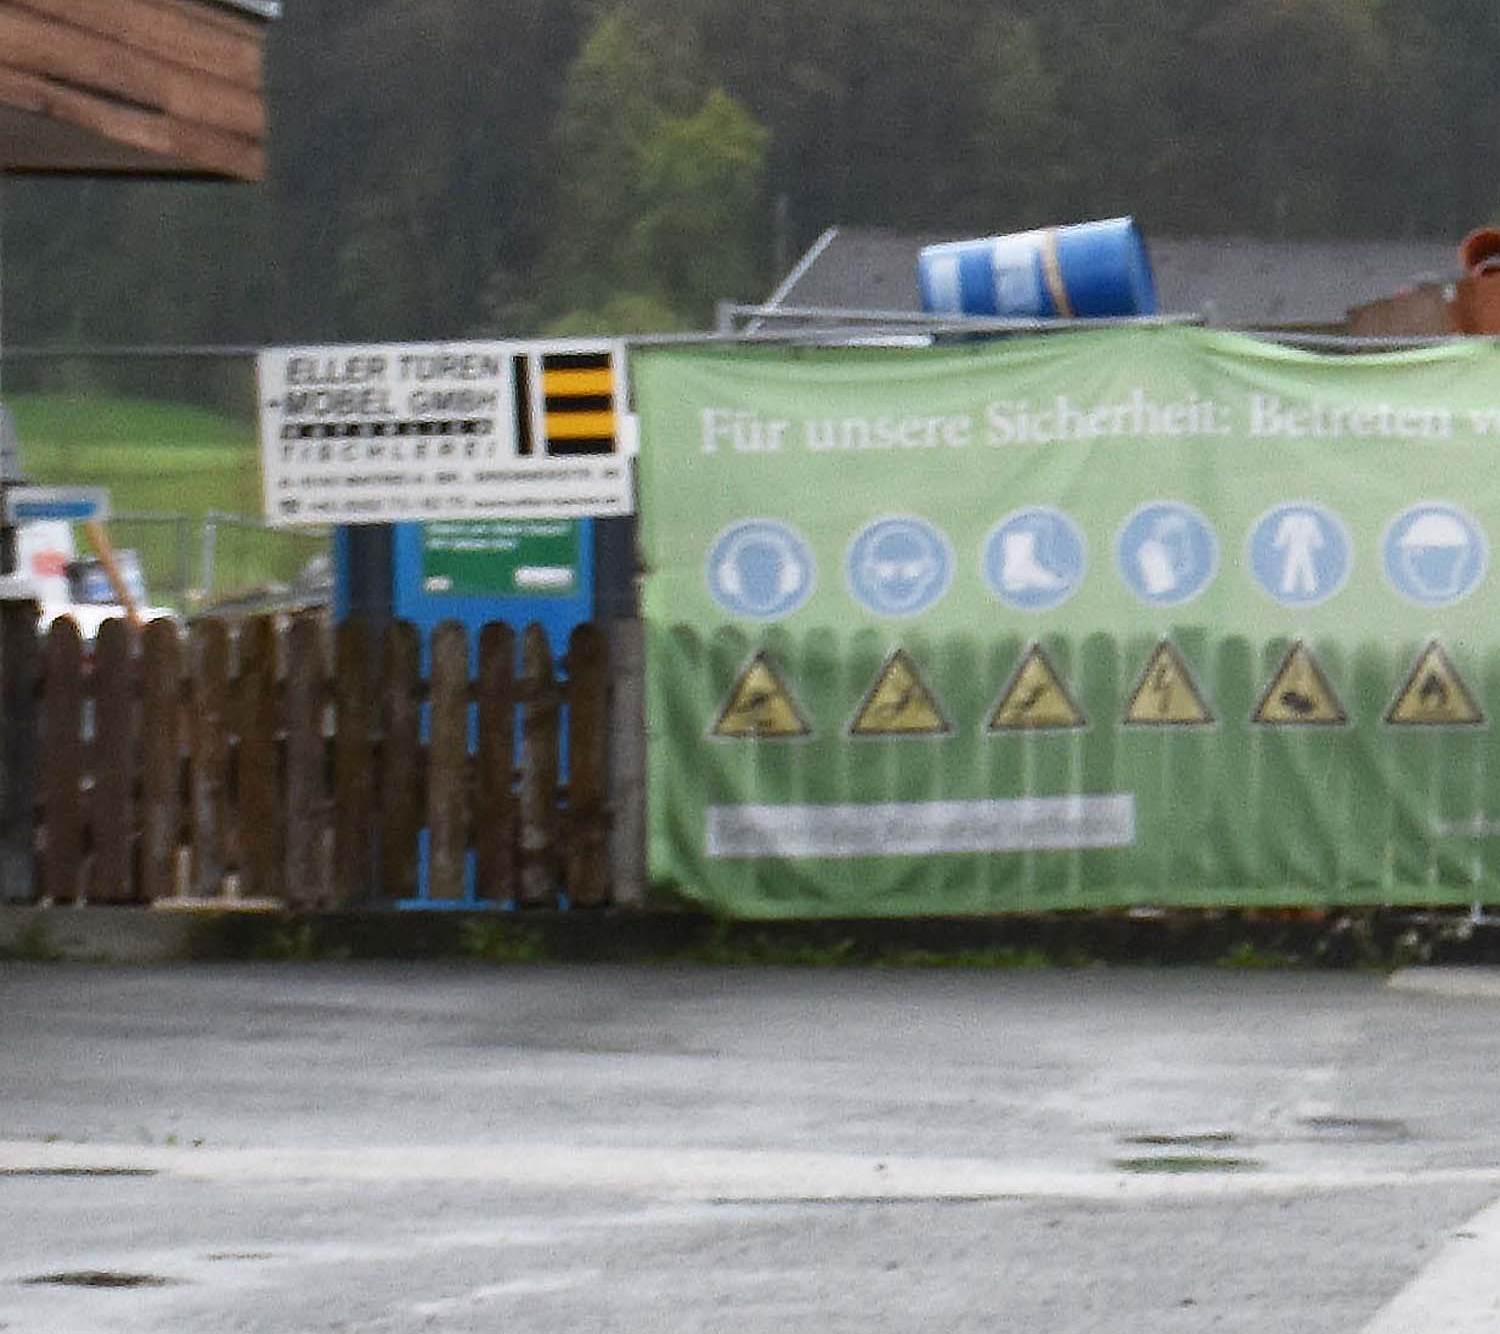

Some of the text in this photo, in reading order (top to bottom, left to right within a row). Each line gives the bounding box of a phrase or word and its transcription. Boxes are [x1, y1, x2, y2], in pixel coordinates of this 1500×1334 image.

[701, 405, 790, 454] Für
[804, 412, 970, 452] unsere
[985, 388, 1231, 446] Sicherheit:
[1248, 394, 1454, 439] Betreten
